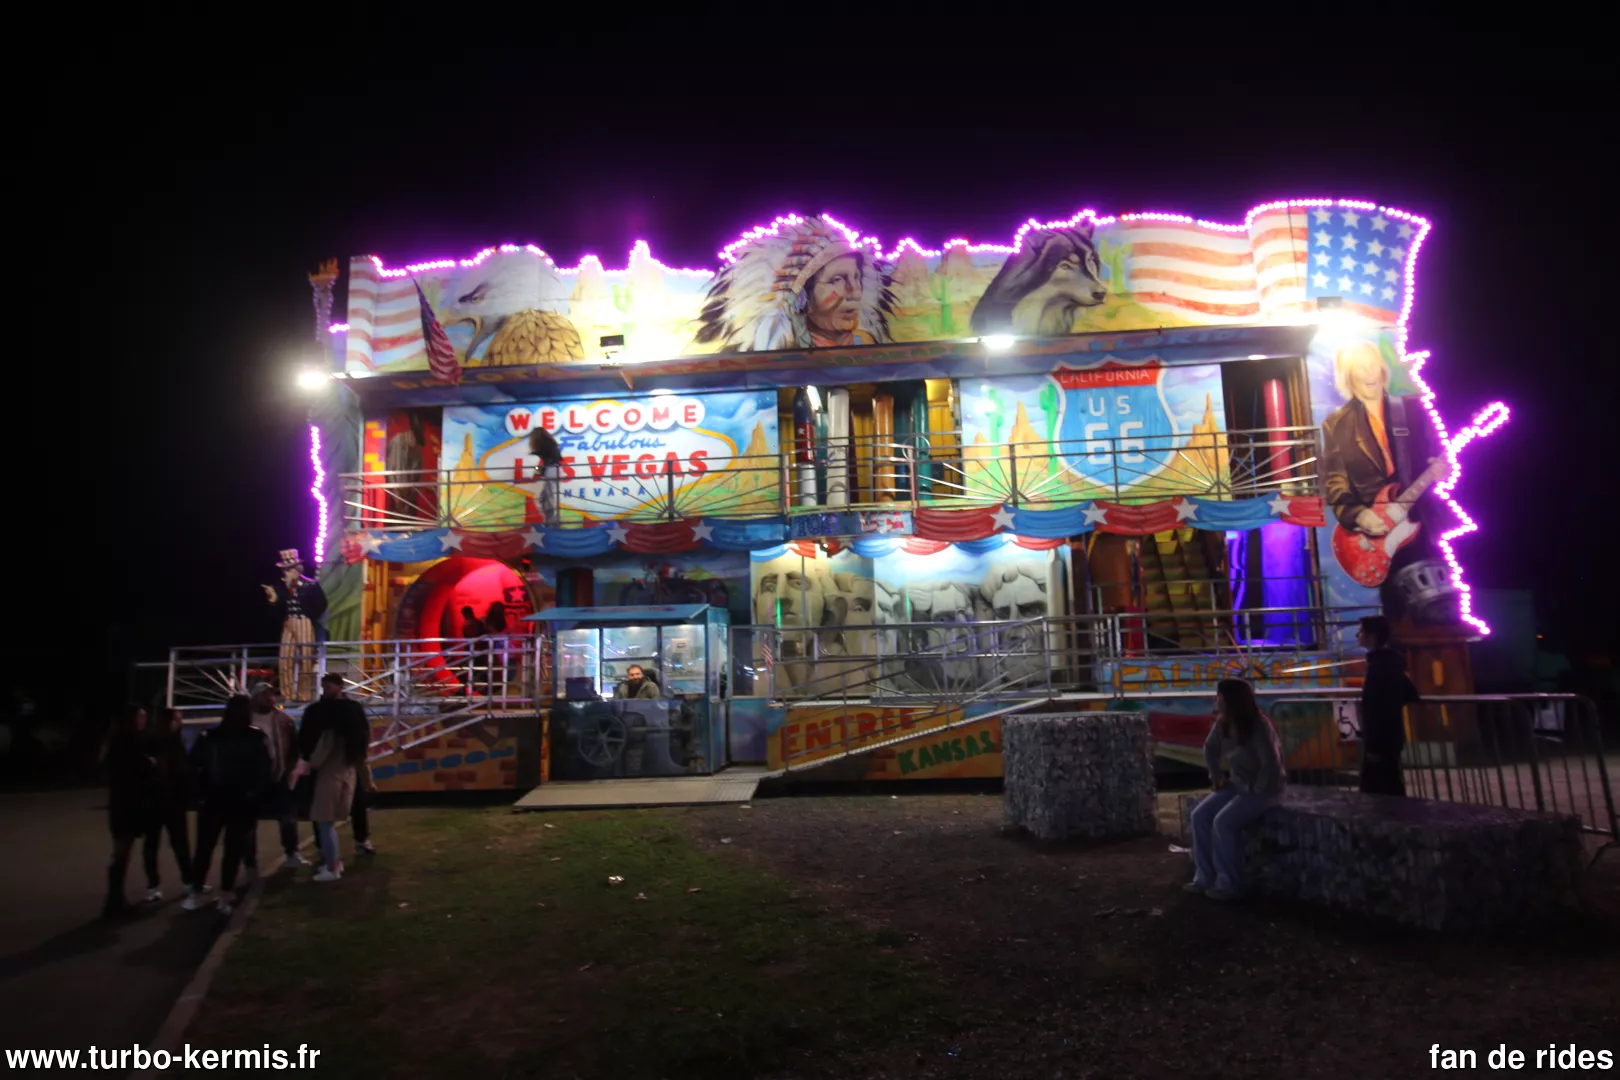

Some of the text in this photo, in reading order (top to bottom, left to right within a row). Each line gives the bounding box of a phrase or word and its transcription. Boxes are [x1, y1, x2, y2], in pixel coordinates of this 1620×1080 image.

[1060, 368, 1151, 385] CALIFORNIA
[508, 404, 697, 429] WELCOME
[559, 431, 667, 453] Fabulous
[1084, 421, 1145, 466] 66
[513, 449, 709, 485] LS VEGAS
[563, 486, 647, 499] NEVADA
[897, 730, 997, 775] KANSAS
